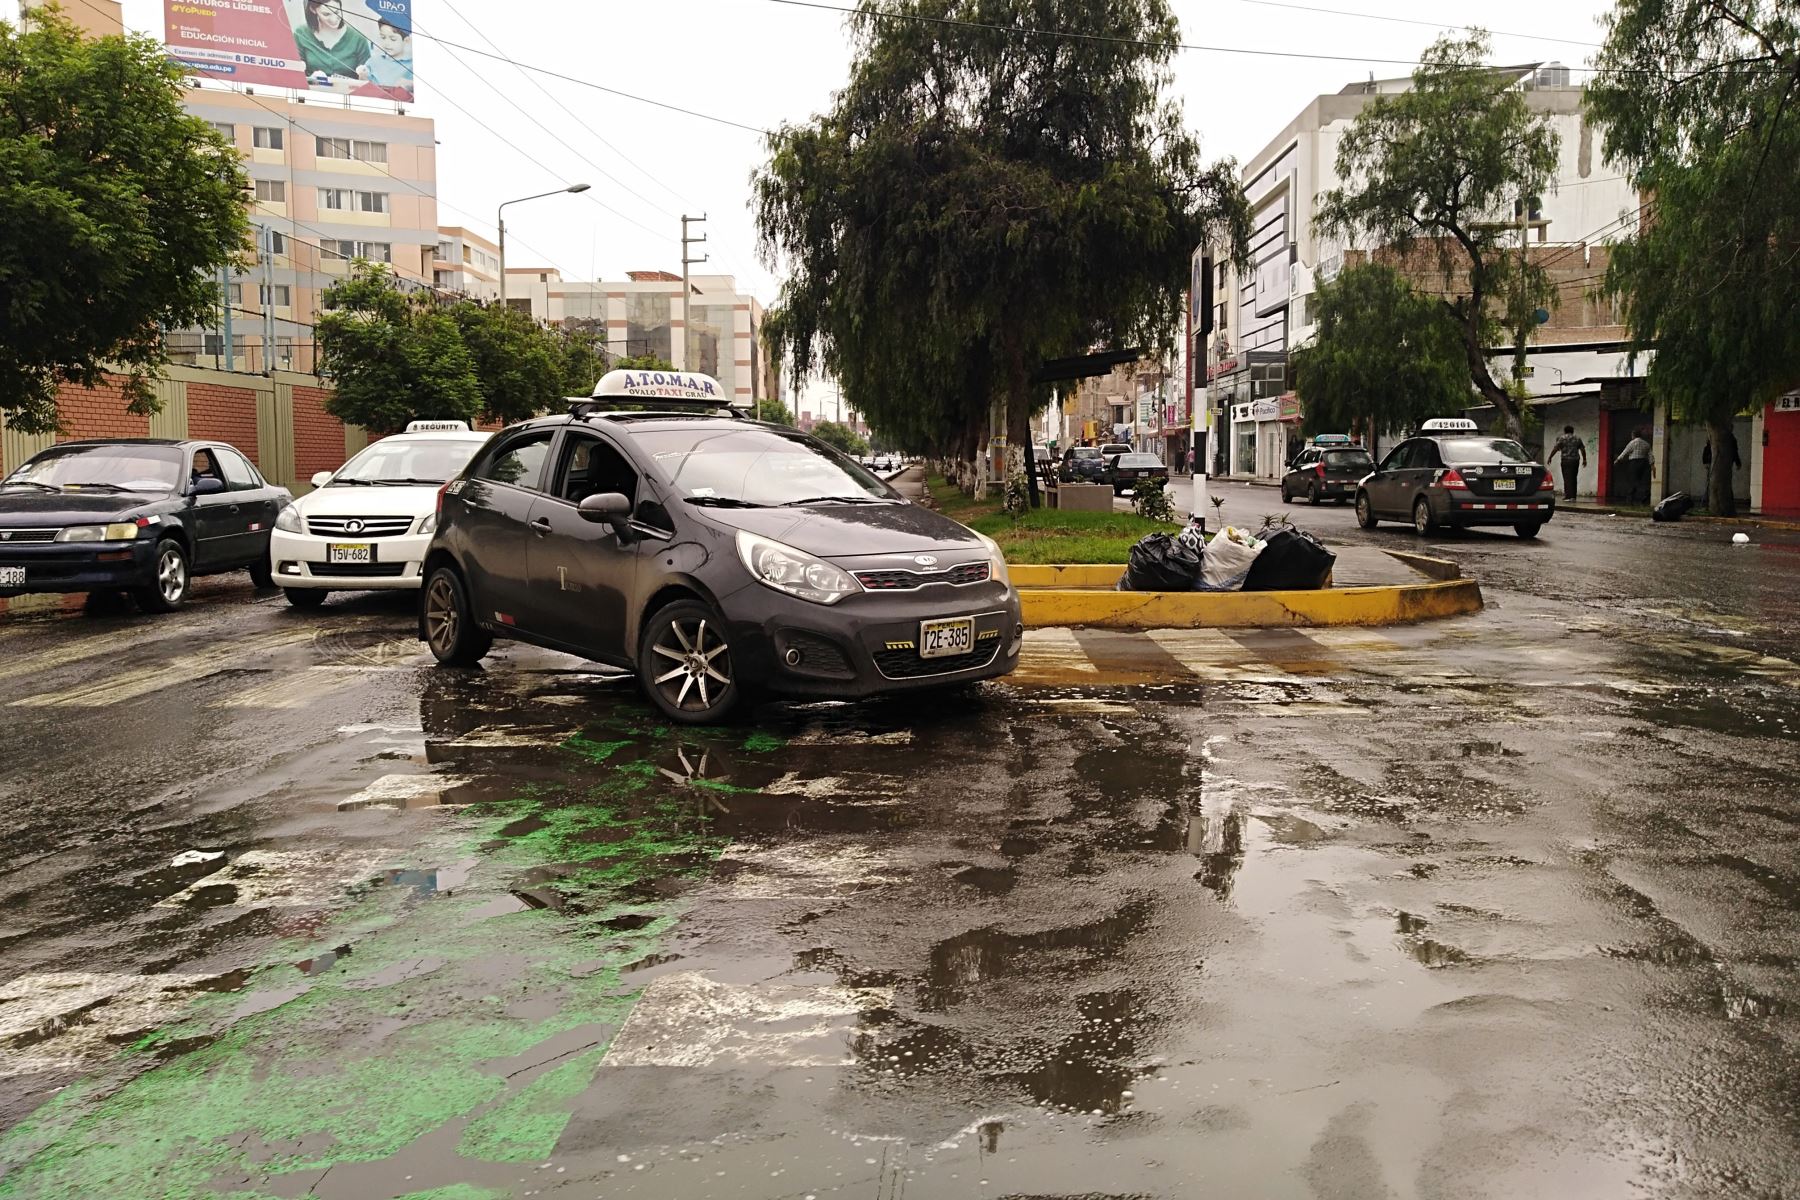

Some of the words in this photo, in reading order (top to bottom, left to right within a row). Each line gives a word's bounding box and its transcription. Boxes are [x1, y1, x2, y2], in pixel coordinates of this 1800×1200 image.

[181, 31, 235, 44] EDUCACIÓN
[236, 38, 268, 48] INICIAL
[235, 54, 242, 62] 8
[243, 56, 257, 64] DE
[258, 58, 286, 68] JULIO
[624, 372, 715, 396] A.T.O.M.A.R
[629, 388, 656, 396] OVALO
[657, 388, 682, 396] TAXI
[333, 549, 368, 560] T5V-682
[924, 627, 968, 650] T2E-385
